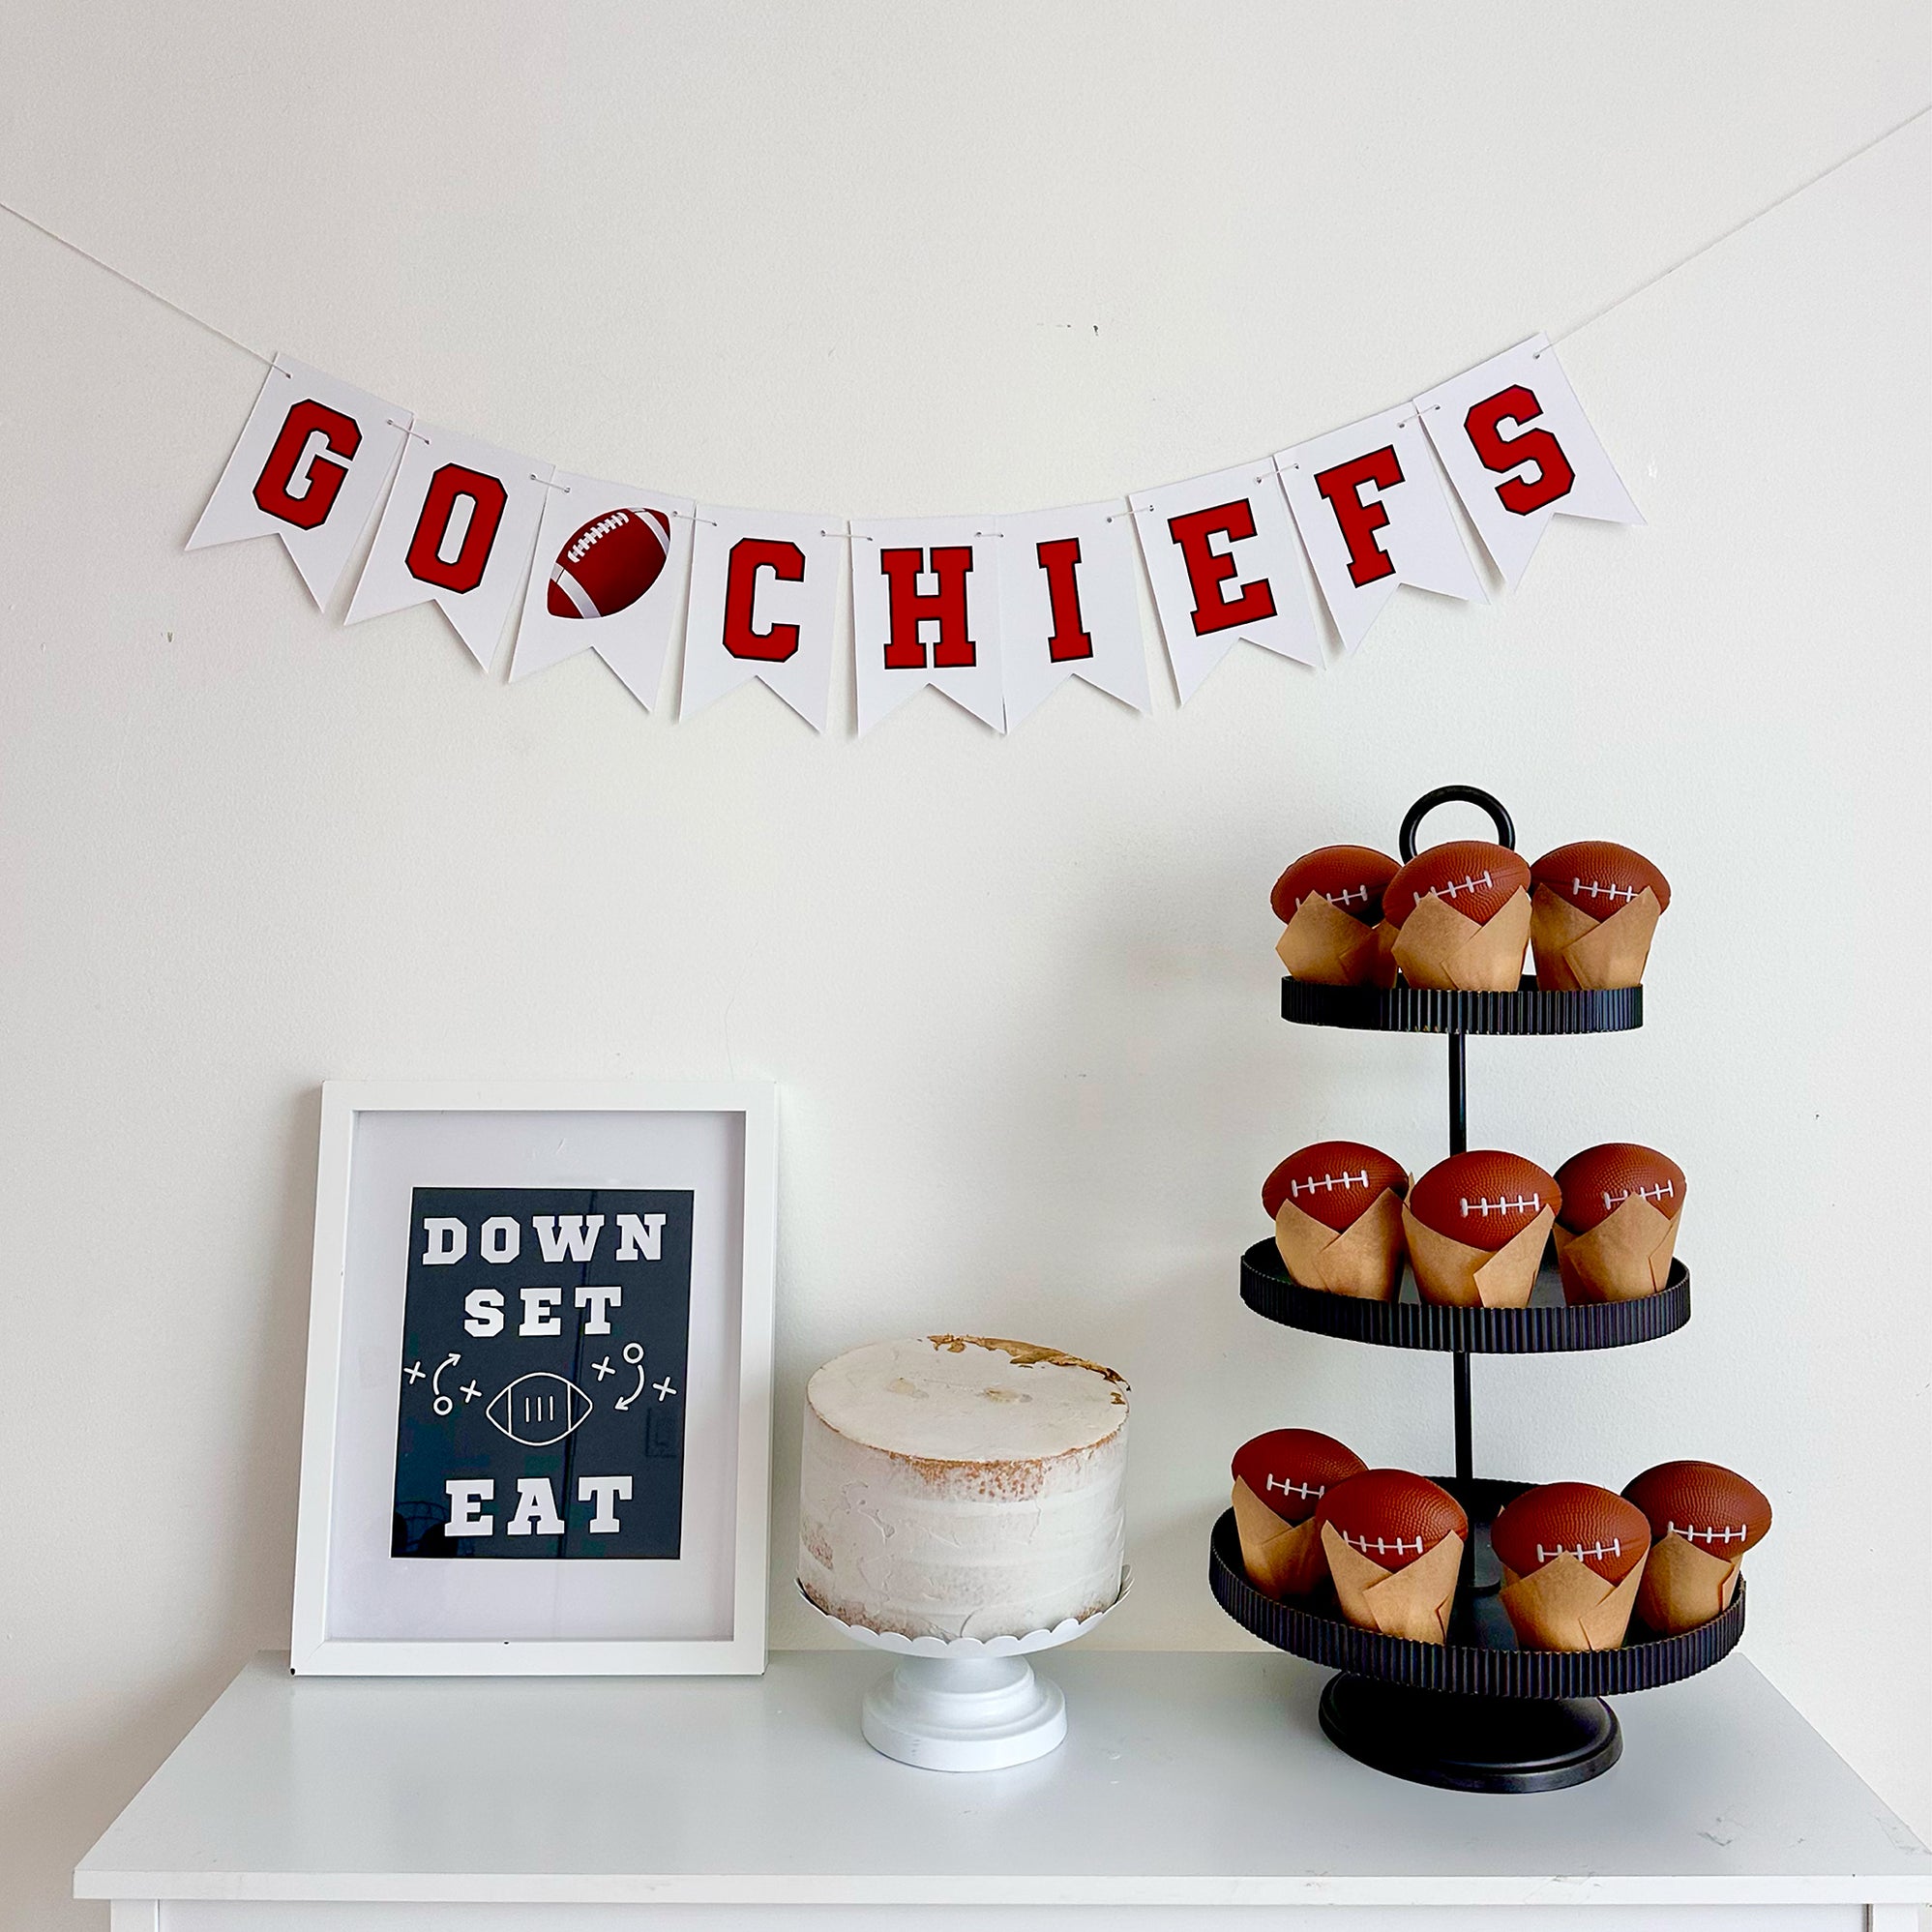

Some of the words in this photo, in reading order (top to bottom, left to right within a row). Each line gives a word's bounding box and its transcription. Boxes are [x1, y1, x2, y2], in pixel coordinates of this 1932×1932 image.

[253, 398, 508, 594] GO
[722, 383, 1577, 670] CHIEFS
[422, 1213, 667, 1265] DOWN
[463, 1286, 622, 1338] SET
[444, 1475, 633, 1537] EAT
